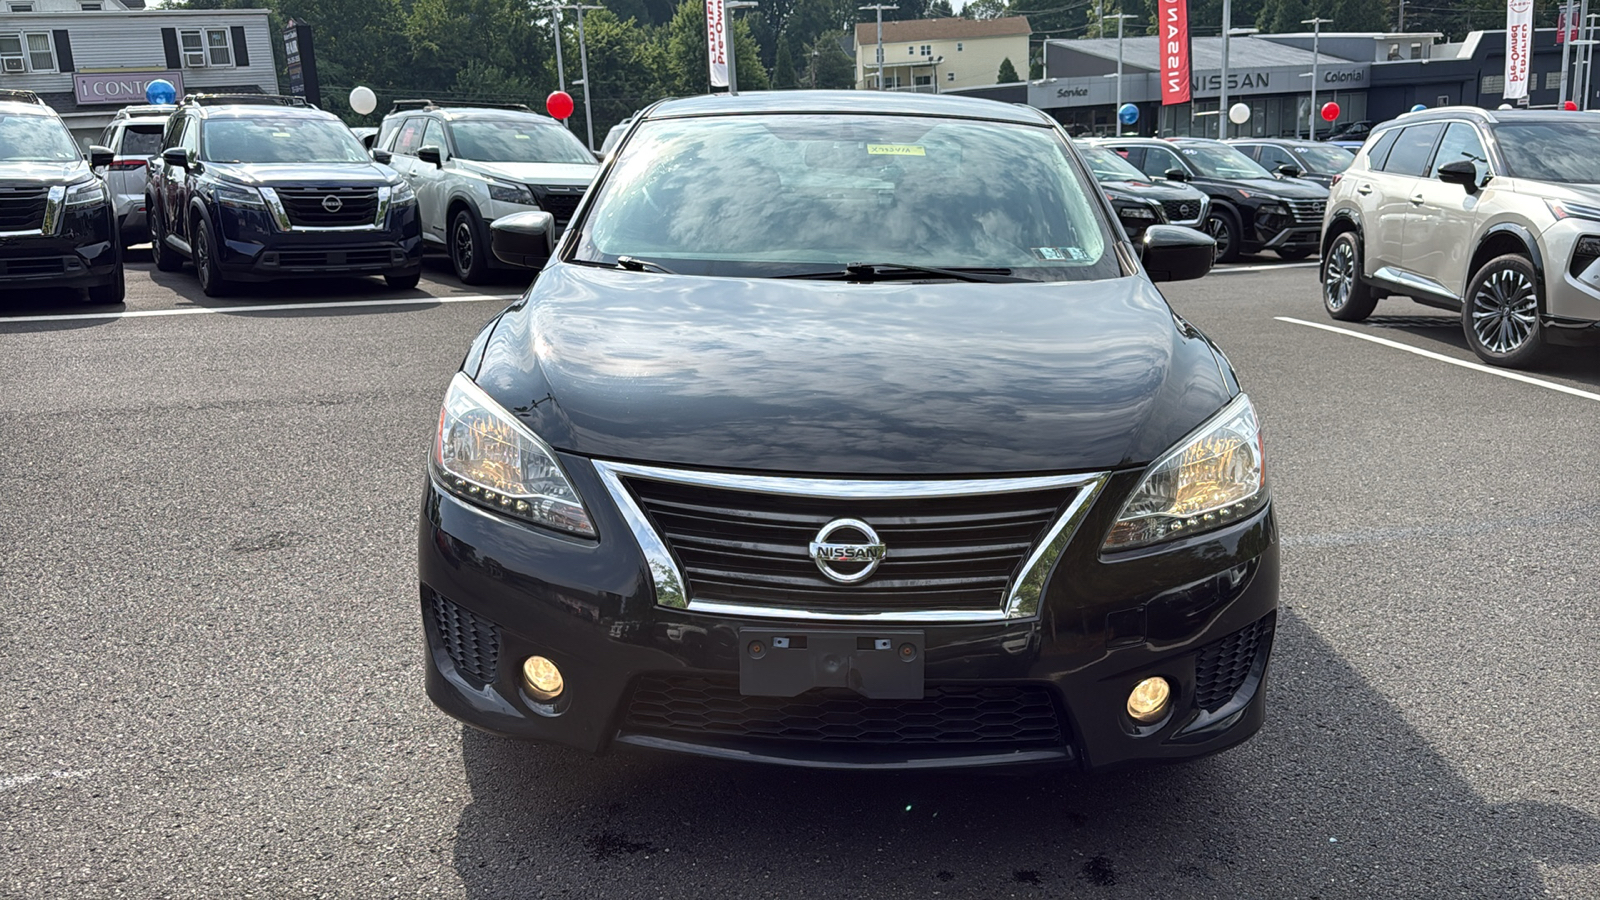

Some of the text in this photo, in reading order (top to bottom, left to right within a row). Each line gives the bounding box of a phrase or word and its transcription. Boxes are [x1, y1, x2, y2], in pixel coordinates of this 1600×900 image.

[1324, 70, 1364, 83] Colonial
[1057, 87, 1088, 98] Service
[817, 546, 878, 558] NISSAN
